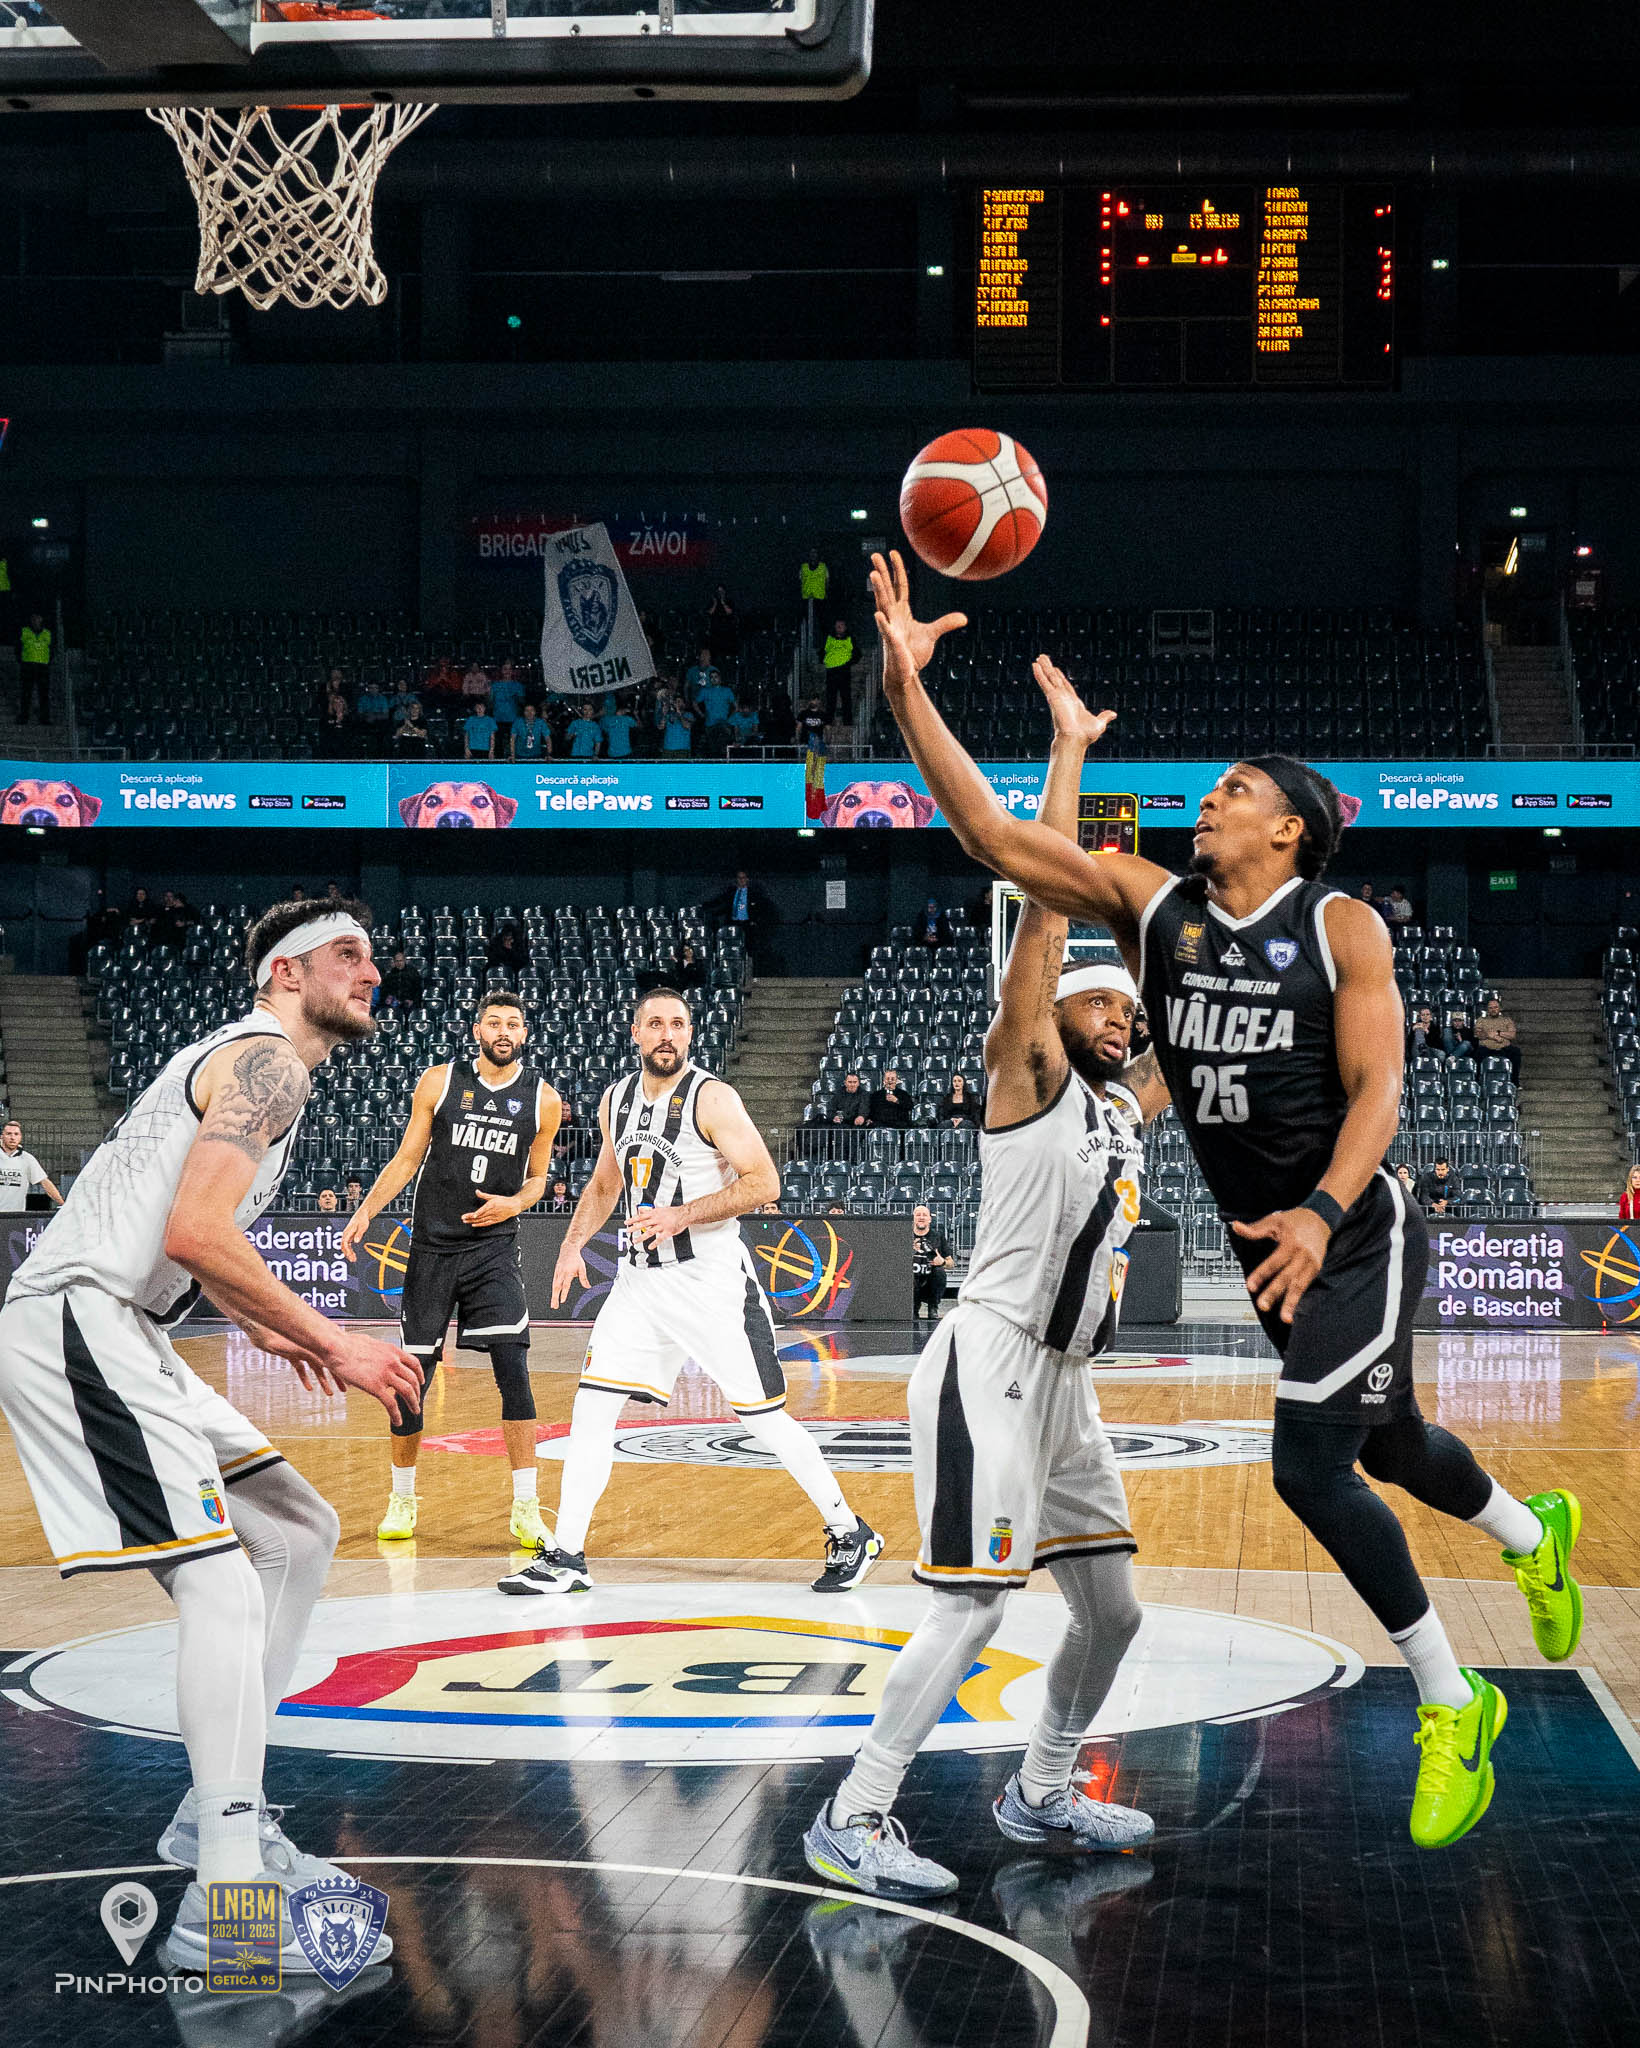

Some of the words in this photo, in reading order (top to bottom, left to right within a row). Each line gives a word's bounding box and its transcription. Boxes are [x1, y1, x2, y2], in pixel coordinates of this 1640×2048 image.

[629, 526, 687, 556] ZĂVOI
[120, 774, 163, 783] Descarcă
[536, 774, 579, 785] Descarcă
[1379, 773, 1423, 783] Descarcă
[119, 788, 237, 809] TelePaws
[535, 789, 653, 811] TelePaws
[1378, 788, 1499, 809] TelePaws
[1220, 955, 1246, 966] PEAK
[1182, 971, 1229, 991] CONSILIUL
[1165, 992, 1294, 1054] VÂLCEA
[1191, 1064, 1250, 1124] 25
[451, 1122, 518, 1156] VÂLCEA
[635, 1132, 683, 1168] TRANSILVANIA
[470, 1155, 489, 1184] 9
[629, 1157, 654, 1189] 17
[245, 1224, 344, 1257] ederația
[1438, 1231, 1564, 1264] Federația
[267, 1253, 348, 1282] mână
[1438, 1260, 1563, 1290] Română
[298, 1287, 347, 1308] chet
[1438, 1295, 1466, 1316] de
[1473, 1296, 1562, 1317] Baschet
